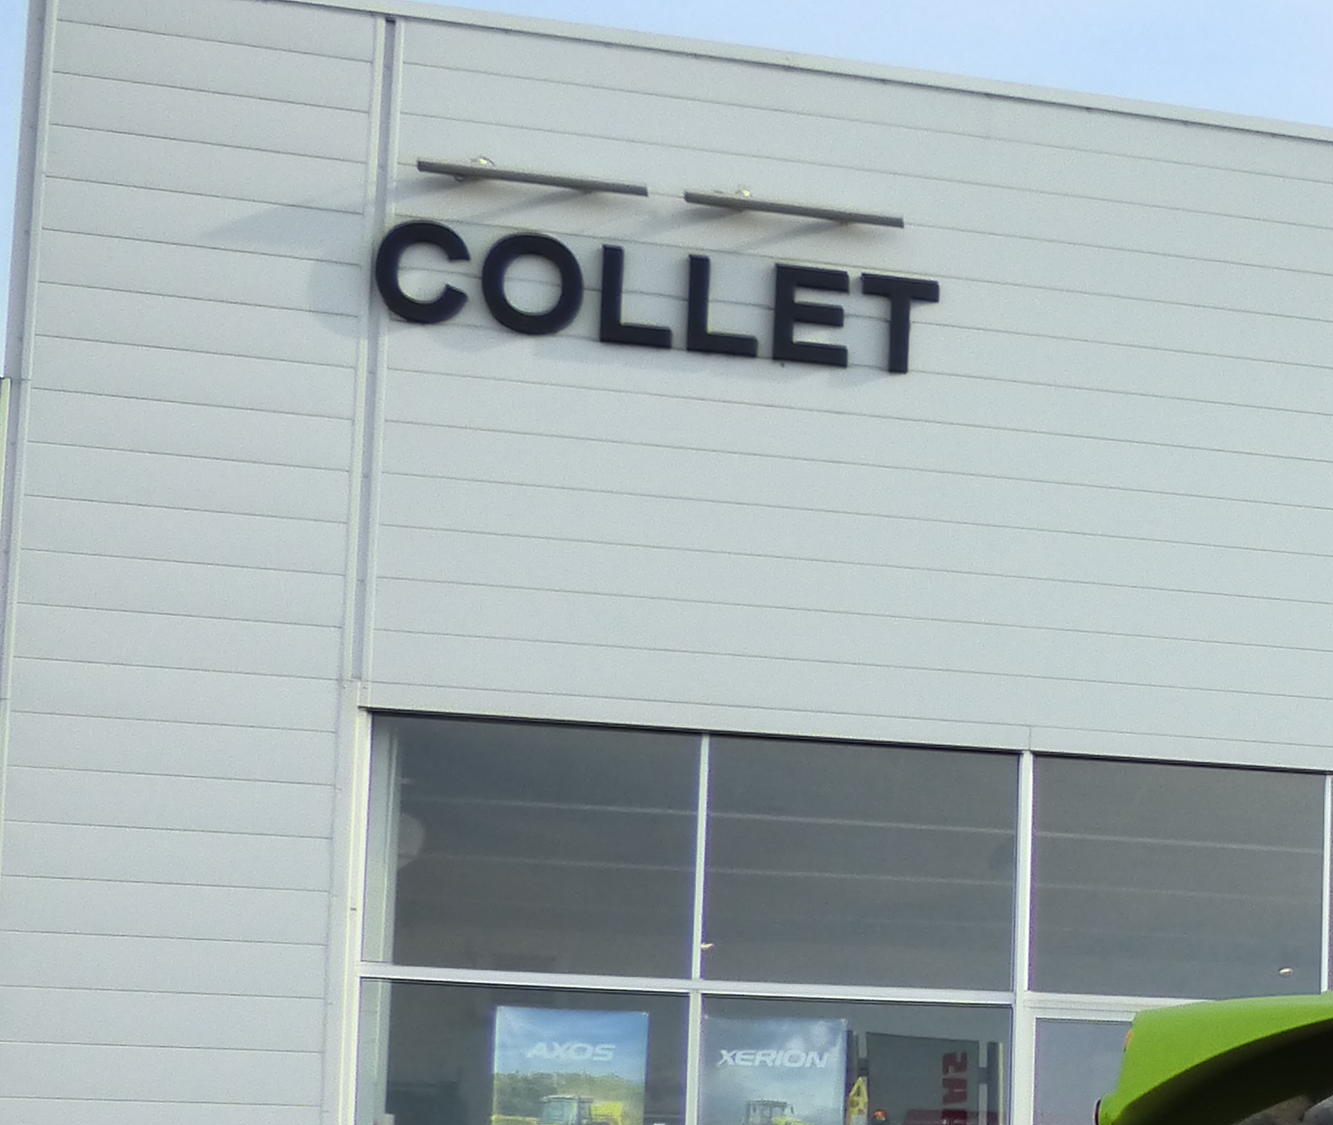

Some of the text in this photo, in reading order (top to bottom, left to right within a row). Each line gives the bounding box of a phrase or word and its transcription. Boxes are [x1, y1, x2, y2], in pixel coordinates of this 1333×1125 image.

[371, 219, 939, 376] COLLET
[525, 1042, 616, 1061] AXOS
[717, 1049, 829, 1069] XERION
